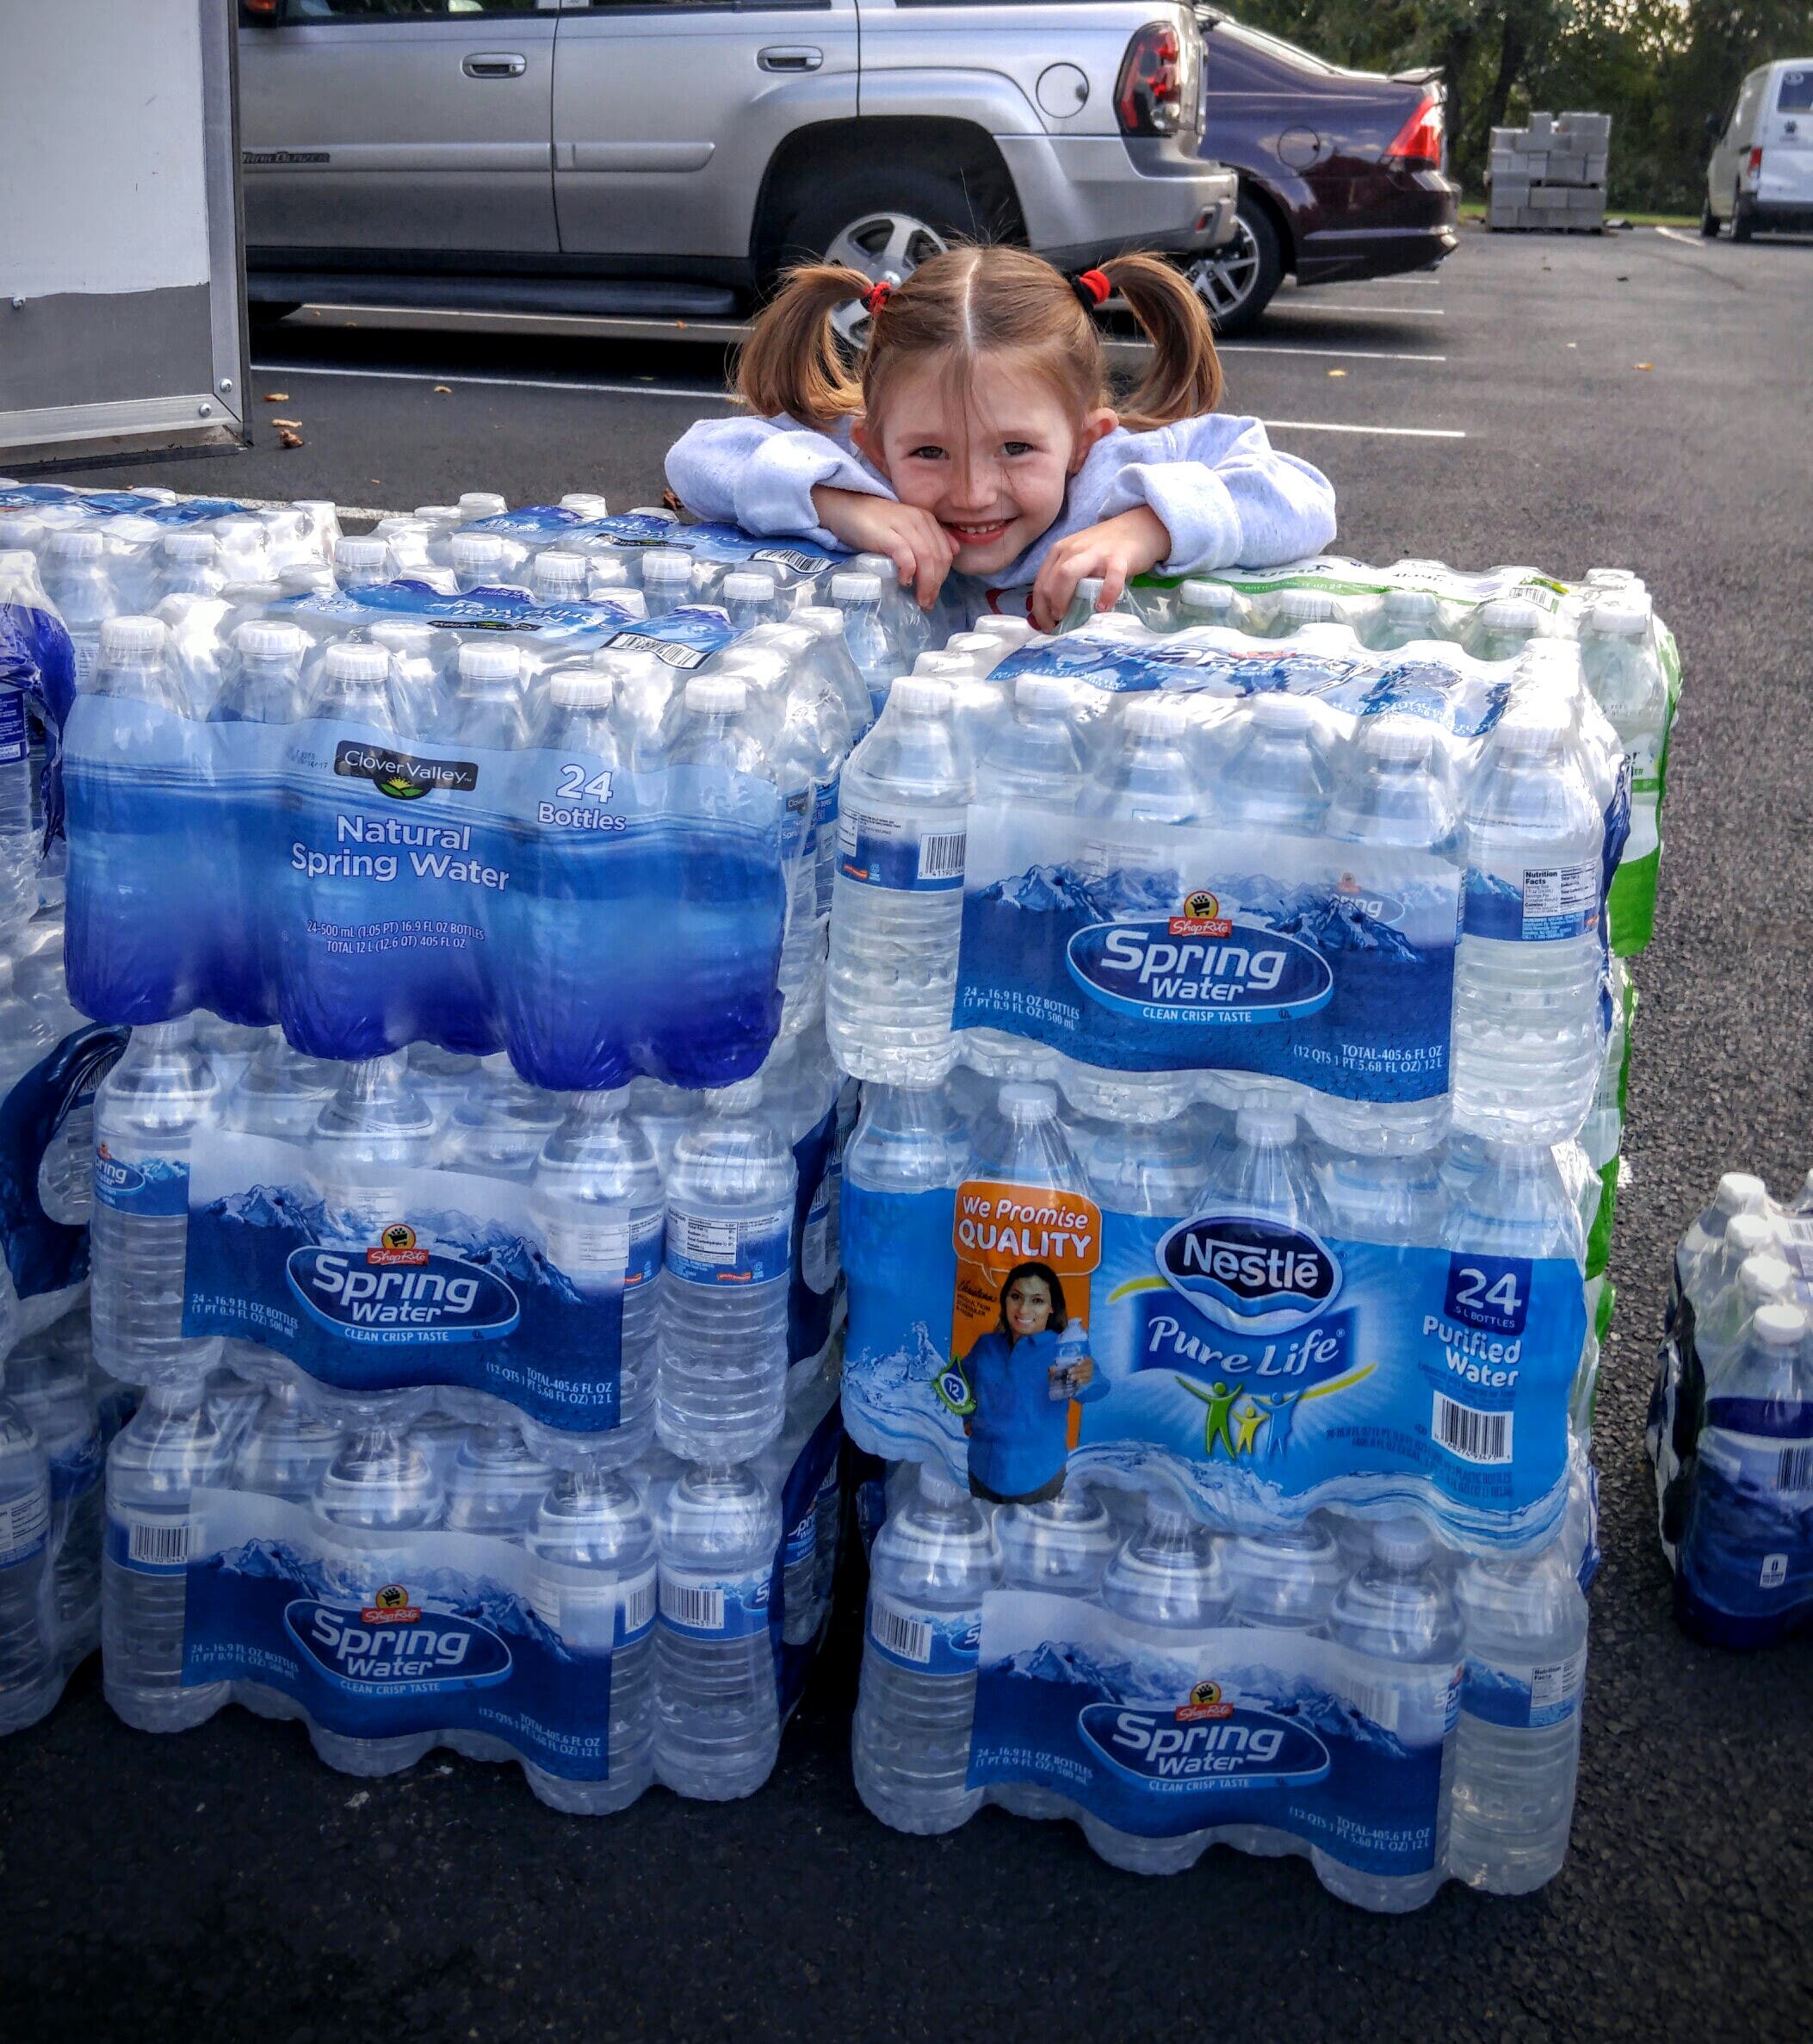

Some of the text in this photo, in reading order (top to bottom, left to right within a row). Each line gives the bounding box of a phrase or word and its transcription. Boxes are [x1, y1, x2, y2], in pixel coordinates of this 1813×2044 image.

[344, 750, 404, 773] Clover
[406, 762, 467, 784] Valley
[556, 764, 613, 803] 24
[337, 815, 472, 852] Natural
[538, 802, 627, 832] Bottles
[291, 842, 510, 891] Spring Water
[341, 927, 355, 938] mL
[383, 922, 399, 934] PT)
[401, 920, 421, 932] 16.9
[423, 921, 433, 932] FL
[436, 921, 449, 932] OZ
[450, 922, 485, 939] BOTTLES
[1171, 919, 1228, 936] ShopRite
[327, 940, 353, 953] TOTAL
[356, 940, 366, 953] 12
[368, 940, 373, 952] L
[420, 936, 438, 947] 405
[441, 937, 450, 947] FL
[454, 938, 467, 948] OZ
[1101, 929, 1288, 990] Spring
[964, 986, 1080, 1019] 24 16.9 FL OZ BOTTLES
[1153, 975, 1245, 1001] Water
[963, 996, 1074, 1031] (1 PT 0.9 FL OZ) 500 mL
[1142, 1007, 1252, 1023] CLEAN CRISP TASTE
[1294, 1044, 1442, 1073] (12 QTS 1 PT 5.68 FL OZ) 12 L
[1415, 1049, 1426, 1060] FL
[1428, 1045, 1443, 1058] OZ
[962, 1195, 1089, 1230] We Promise
[958, 1219, 1092, 1259] QUALITY
[371, 1249, 425, 1264] ShopRite
[312, 1254, 479, 1312] Spring
[1456, 1268, 1522, 1316] 24
[192, 1303, 294, 1338] (1 PT 0.9 FL OZ) 500 mL
[193, 1293, 298, 1329] 24 16.9 FL OZ BOTTLES
[351, 1301, 442, 1322] Water
[1470, 1312, 1515, 1328] BOTTLES
[345, 1329, 449, 1341] CLEAN CRISP TASTE
[1149, 1315, 1340, 1377] Pure Life
[1423, 1315, 1521, 1364] Purified
[1446, 1345, 1519, 1387] Water
[486, 1362, 612, 1405] (12 QTS 1 PT 5.68 FL OZ) 12 L
[582, 1383, 592, 1393] FL
[596, 1382, 612, 1393] OZ
[311, 1608, 470, 1664] Spring
[347, 1656, 432, 1677] Water
[340, 1681, 440, 1695] CLEAN CRISP TASTE
[1112, 1712, 1285, 1762] Spring
[1159, 1754, 1244, 1776] Water
[1148, 1779, 1250, 1793] CLEAN CRISP TASTE
